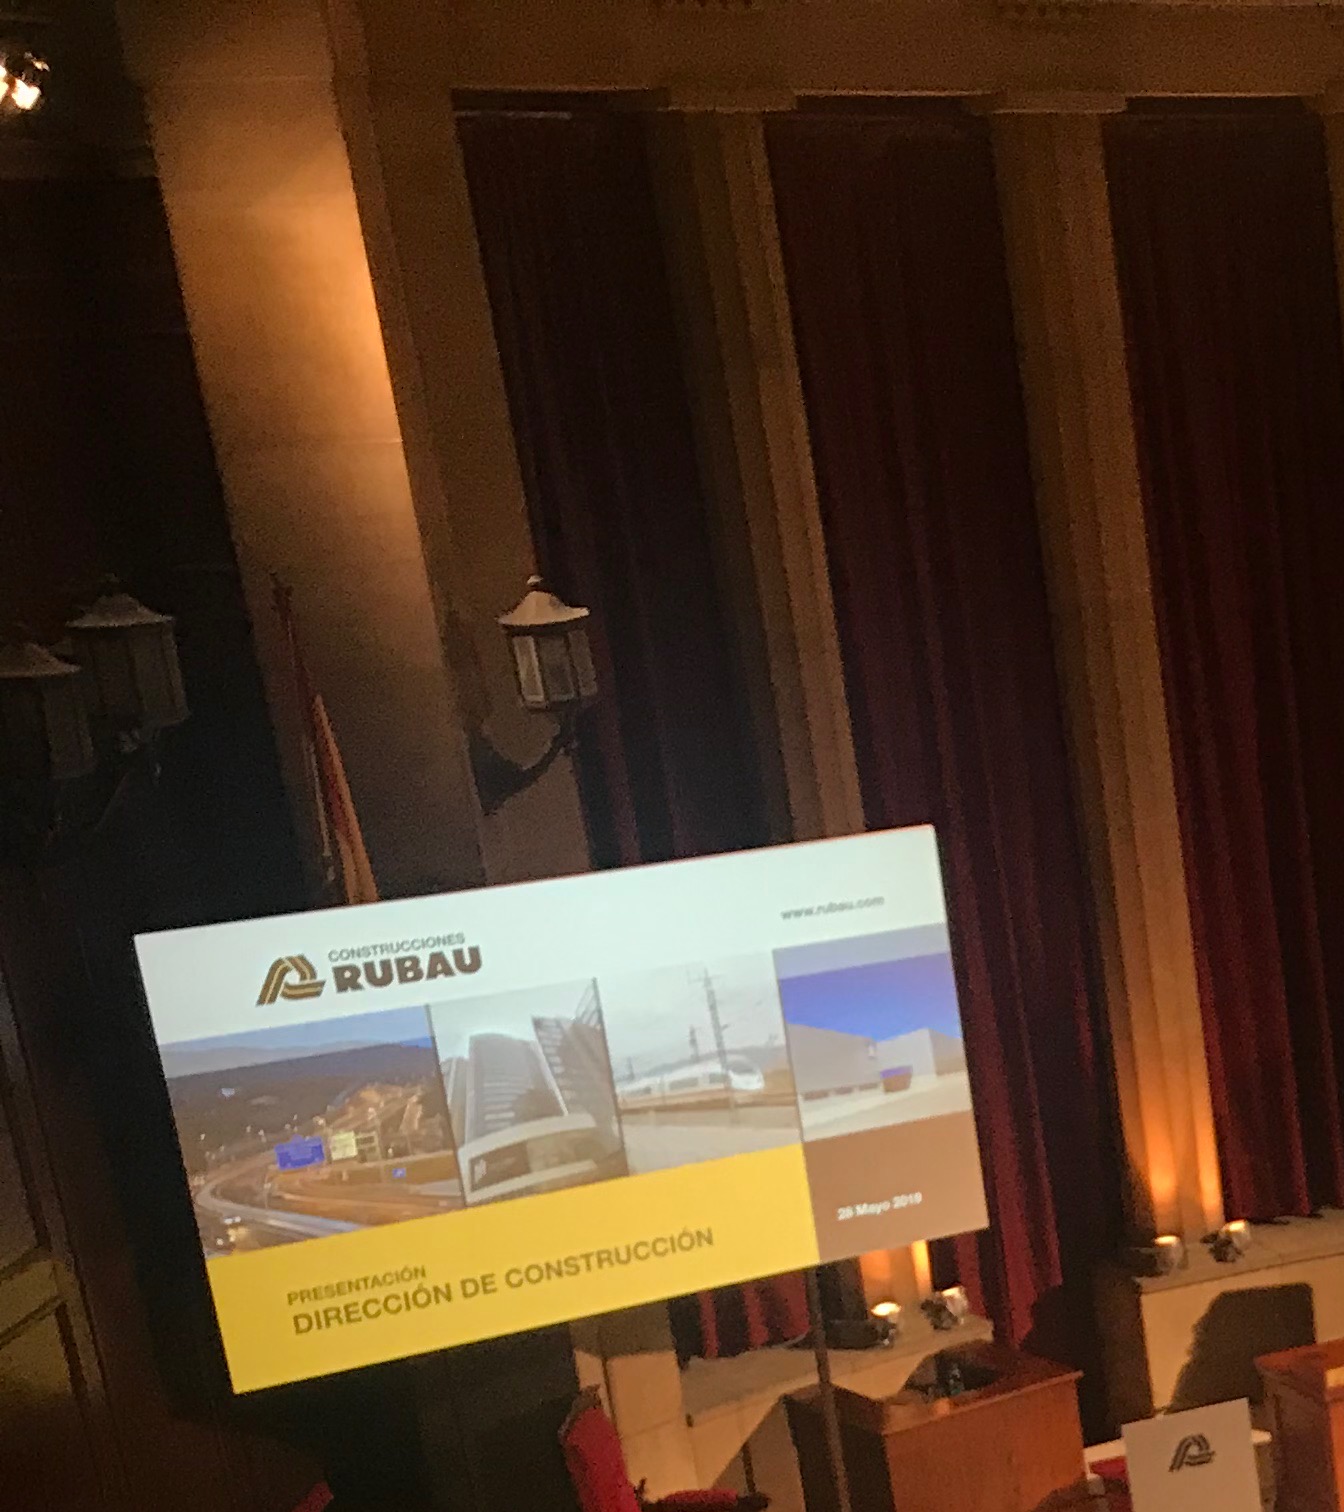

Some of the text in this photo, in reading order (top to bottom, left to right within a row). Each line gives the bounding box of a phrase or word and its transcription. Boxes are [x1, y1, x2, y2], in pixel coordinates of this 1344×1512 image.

[328, 932, 466, 963] CONSTRUCCIONES
[332, 945, 483, 993] RUBAU
[287, 1264, 427, 1306] PRESENTACIÓN
[293, 1226, 715, 1335] DIRECCIÓN DE CONSTRUCCIÓN
